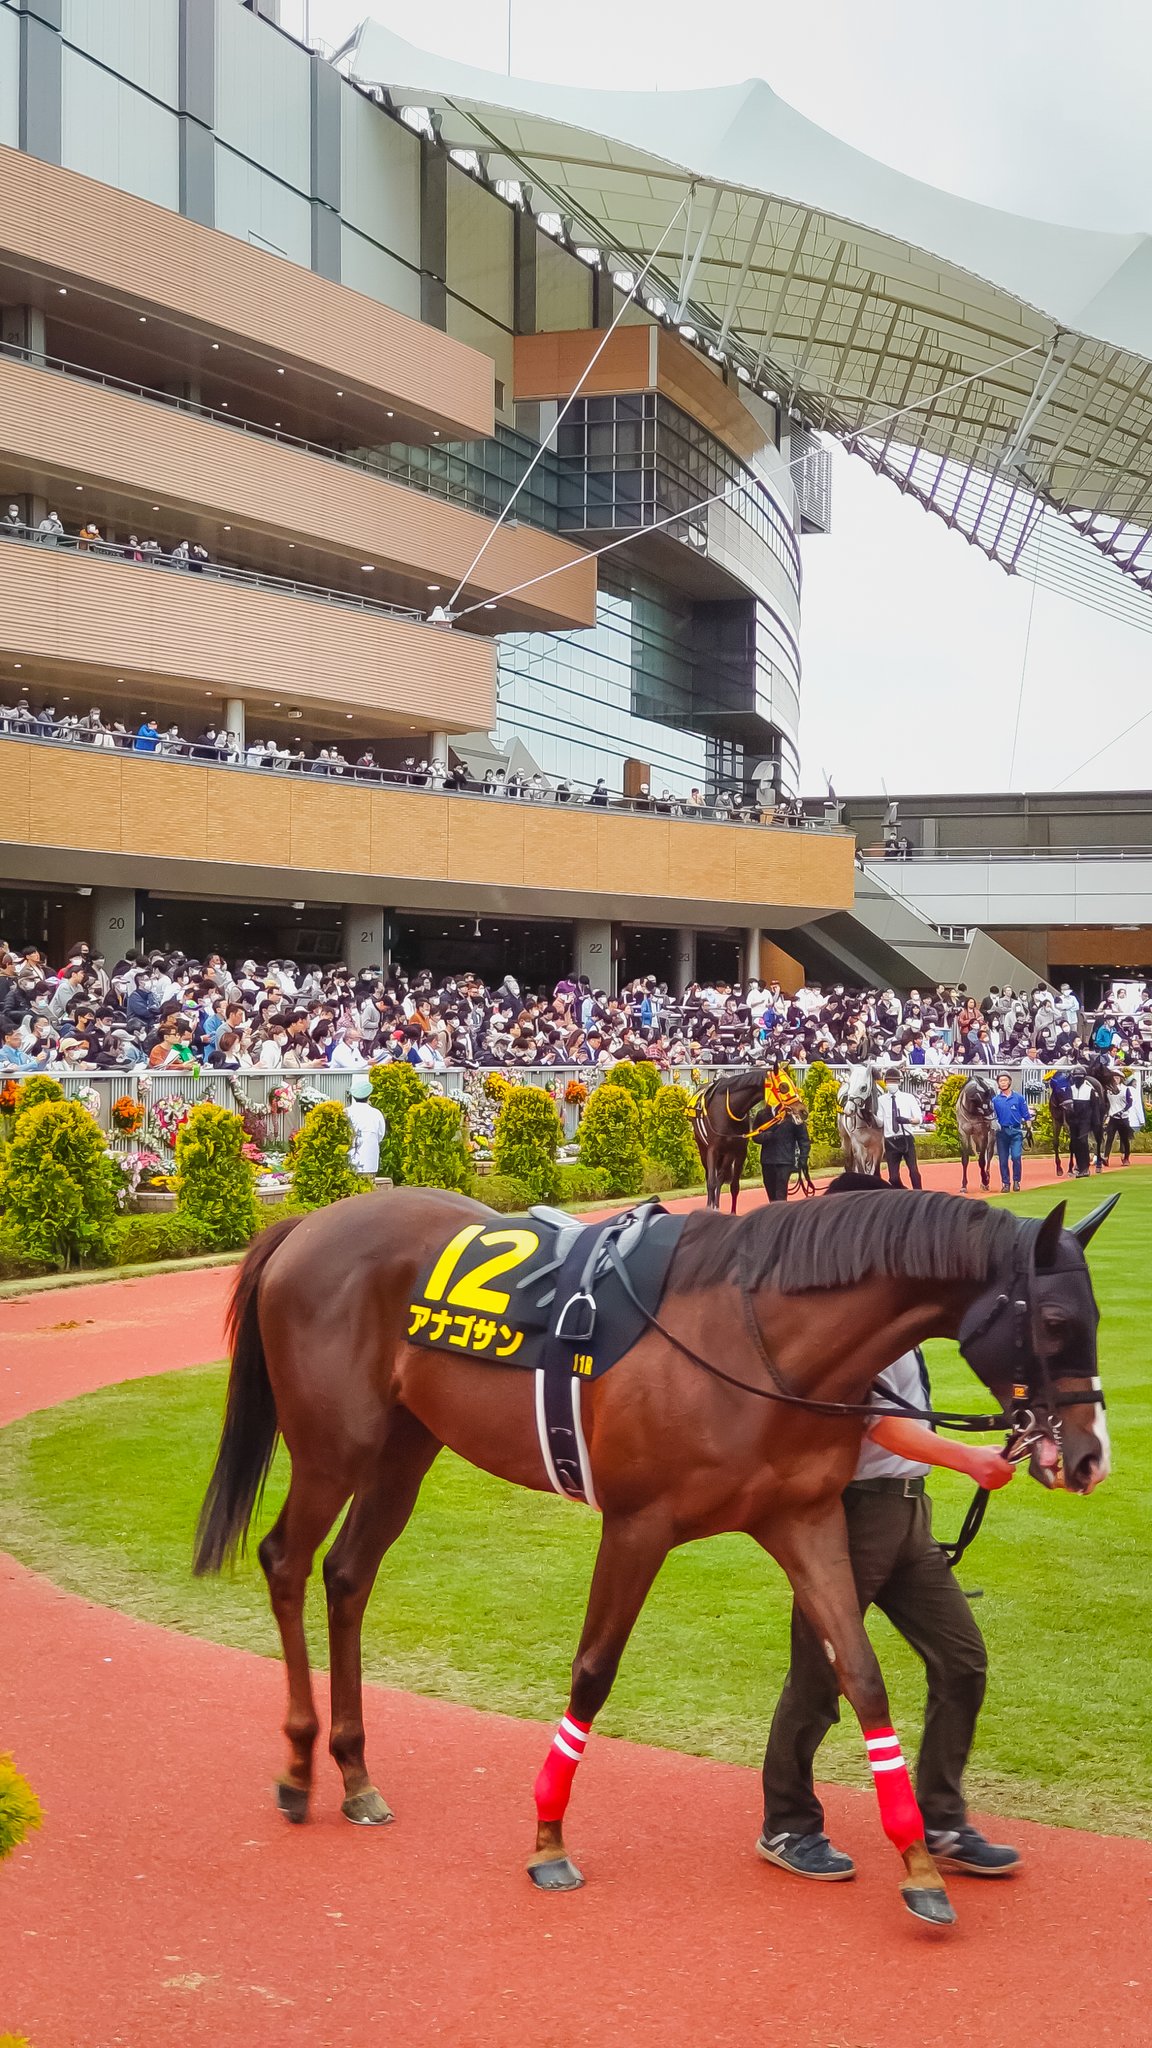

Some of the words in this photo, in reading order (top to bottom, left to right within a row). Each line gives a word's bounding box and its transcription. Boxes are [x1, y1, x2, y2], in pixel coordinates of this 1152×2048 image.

[109, 917, 125, 929] 20
[360, 931, 374, 943] 21
[589, 943, 603, 954] 22
[423, 1224, 540, 1315] 12
[407, 1304, 525, 1357] アナゴサン
